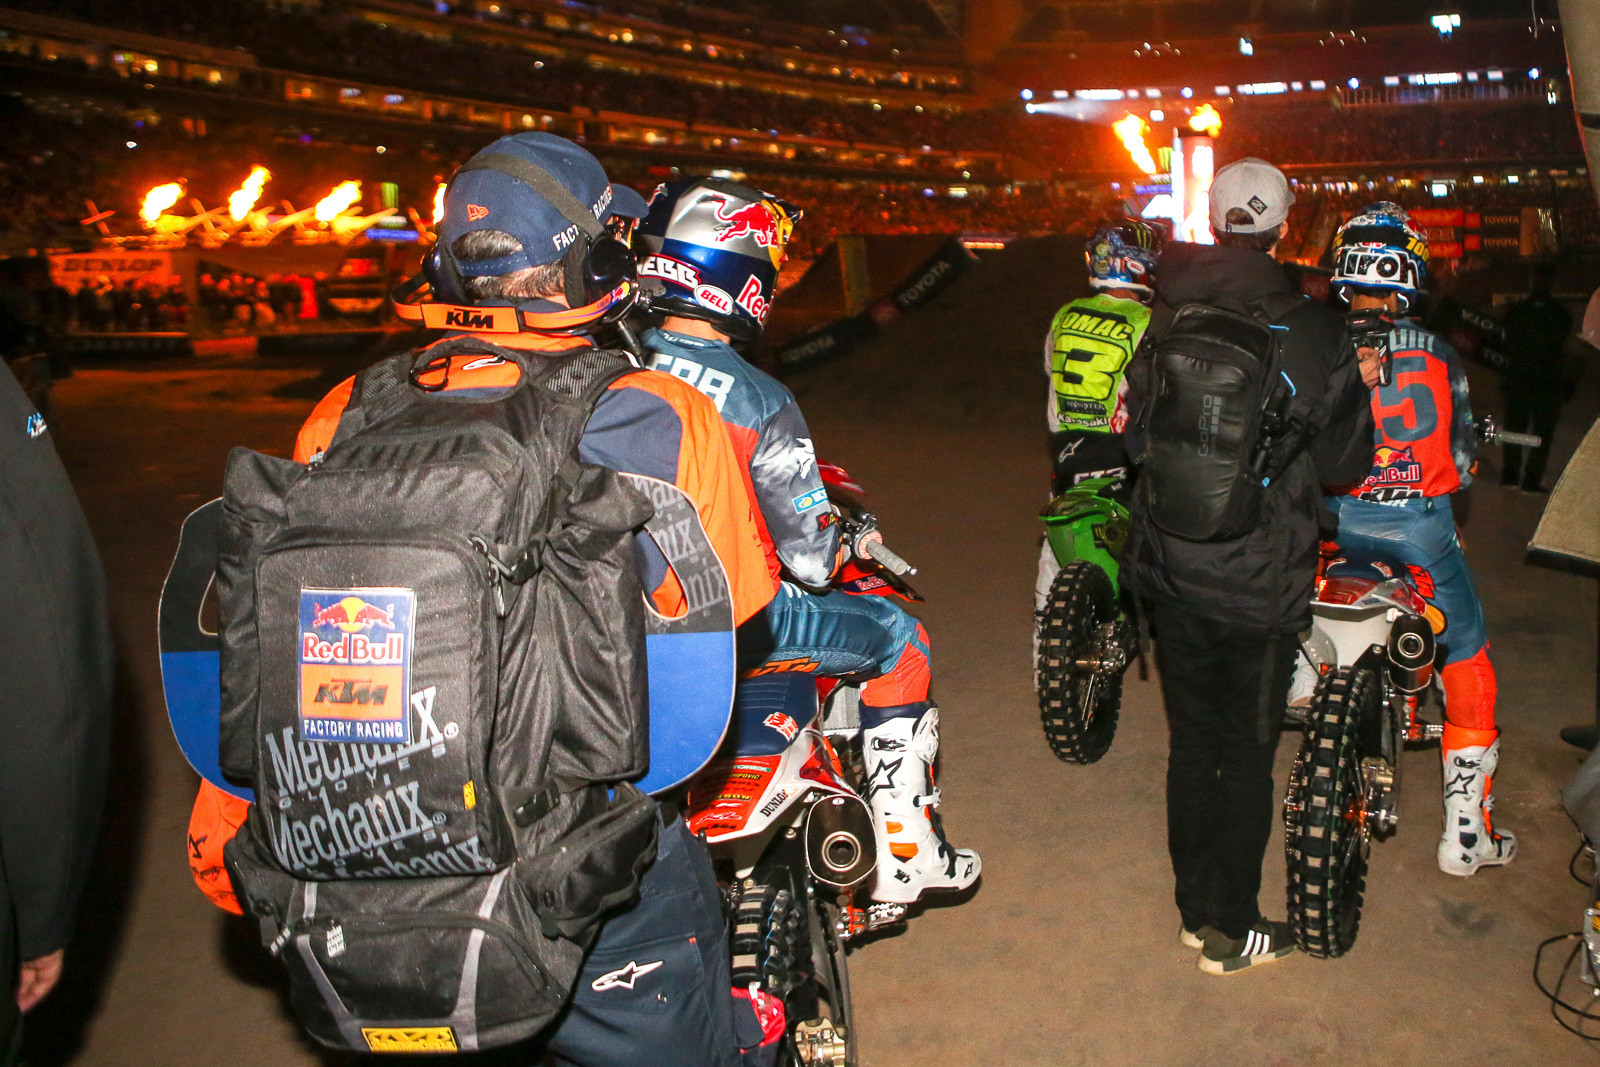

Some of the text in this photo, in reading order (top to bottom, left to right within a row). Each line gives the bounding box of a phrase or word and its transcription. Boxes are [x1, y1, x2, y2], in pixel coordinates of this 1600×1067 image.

[551, 184, 613, 251] FACT RACING
[1483, 215, 1519, 225] TOYOTA
[63, 258, 163, 272] DUNLOP
[637, 256, 699, 291] EBB
[897, 261, 951, 307] TOYOTA
[700, 289, 727, 311] BELL
[446, 308, 494, 330] KTM
[1060, 312, 1134, 340] OMAC
[1052, 333, 1127, 401] 3
[1197, 394, 1212, 457] GoPro
[1387, 463, 1421, 483] Bull
[303, 632, 404, 664] Red Bull
[314, 678, 389, 706] KTM
[265, 685, 444, 798] Mecax
[303, 719, 404, 742] FACTORY RACING
